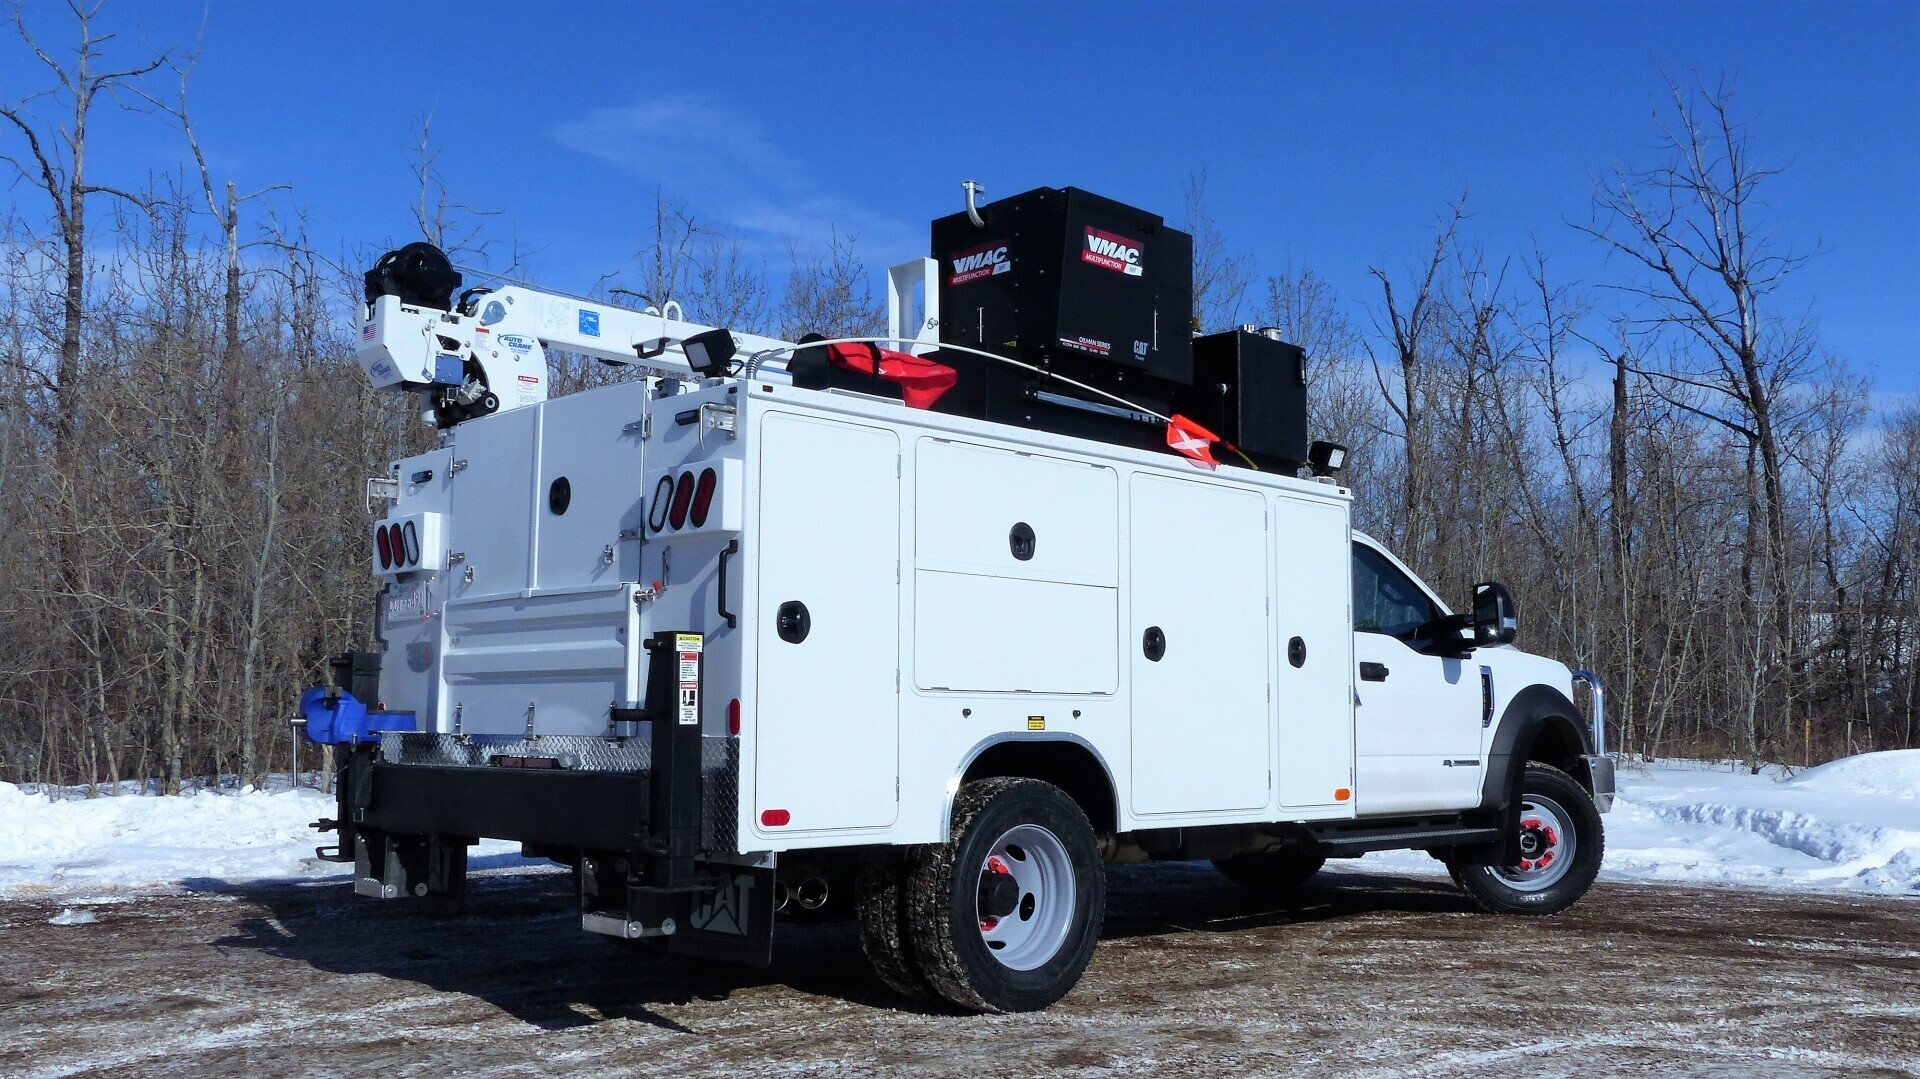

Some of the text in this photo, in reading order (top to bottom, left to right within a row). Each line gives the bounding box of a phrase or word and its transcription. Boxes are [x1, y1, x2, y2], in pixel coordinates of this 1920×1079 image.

[1087, 234, 1139, 264] VMAC
[953, 246, 1007, 274] VMAC
[1085, 253, 1123, 270] MULTIFUNCTION
[952, 268, 990, 284] MULTIFUNCTION
[508, 341, 533, 351] CRANE
[1097, 340, 1111, 350] SERIES
[1133, 340, 1148, 356] CAT
